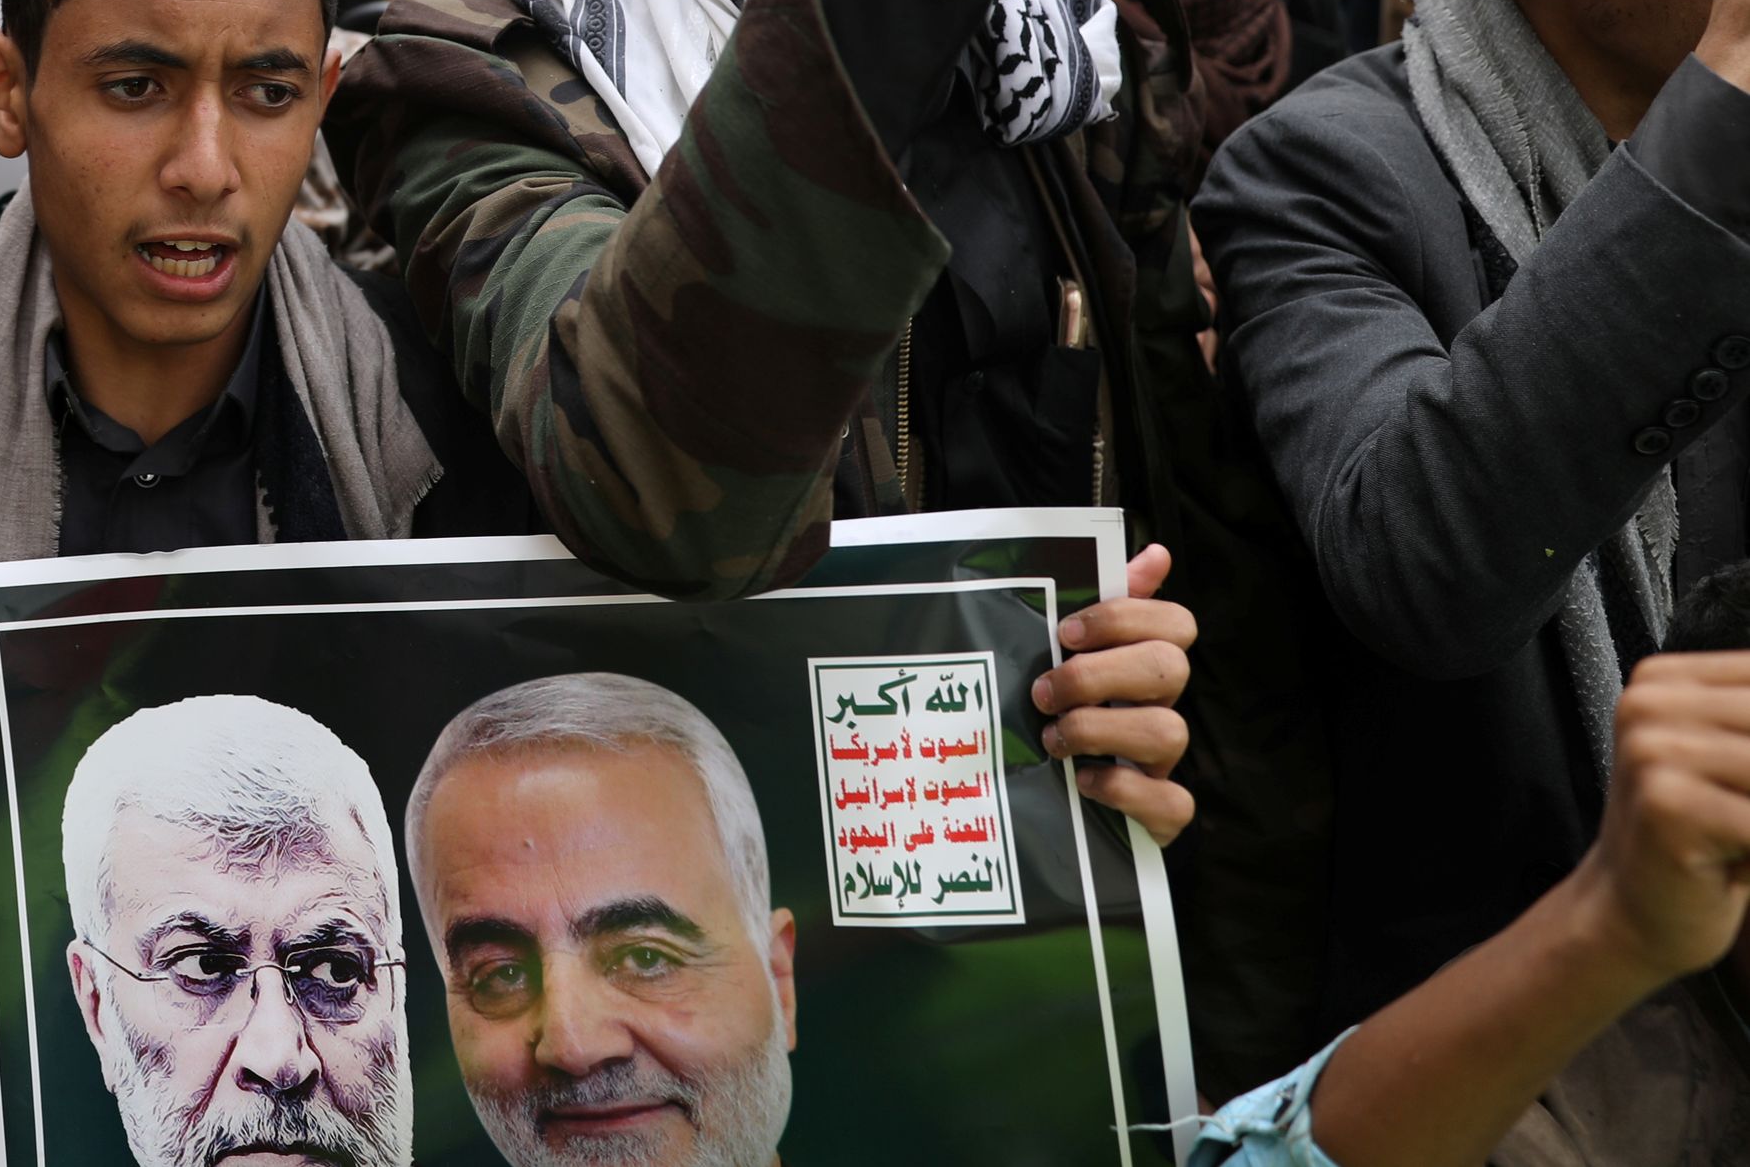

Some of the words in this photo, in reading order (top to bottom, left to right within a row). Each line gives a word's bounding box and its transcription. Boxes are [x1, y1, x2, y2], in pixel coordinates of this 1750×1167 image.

[825, 669, 918, 730] أكبر
[919, 729, 987, 764] الموت
[923, 770, 991, 806] الموت
[838, 820, 897, 855] اليهود
[903, 819, 935, 852] على
[943, 815, 997, 843] اللعنة
[843, 858, 922, 909] للإسلام
[931, 852, 1004, 905] النصر
